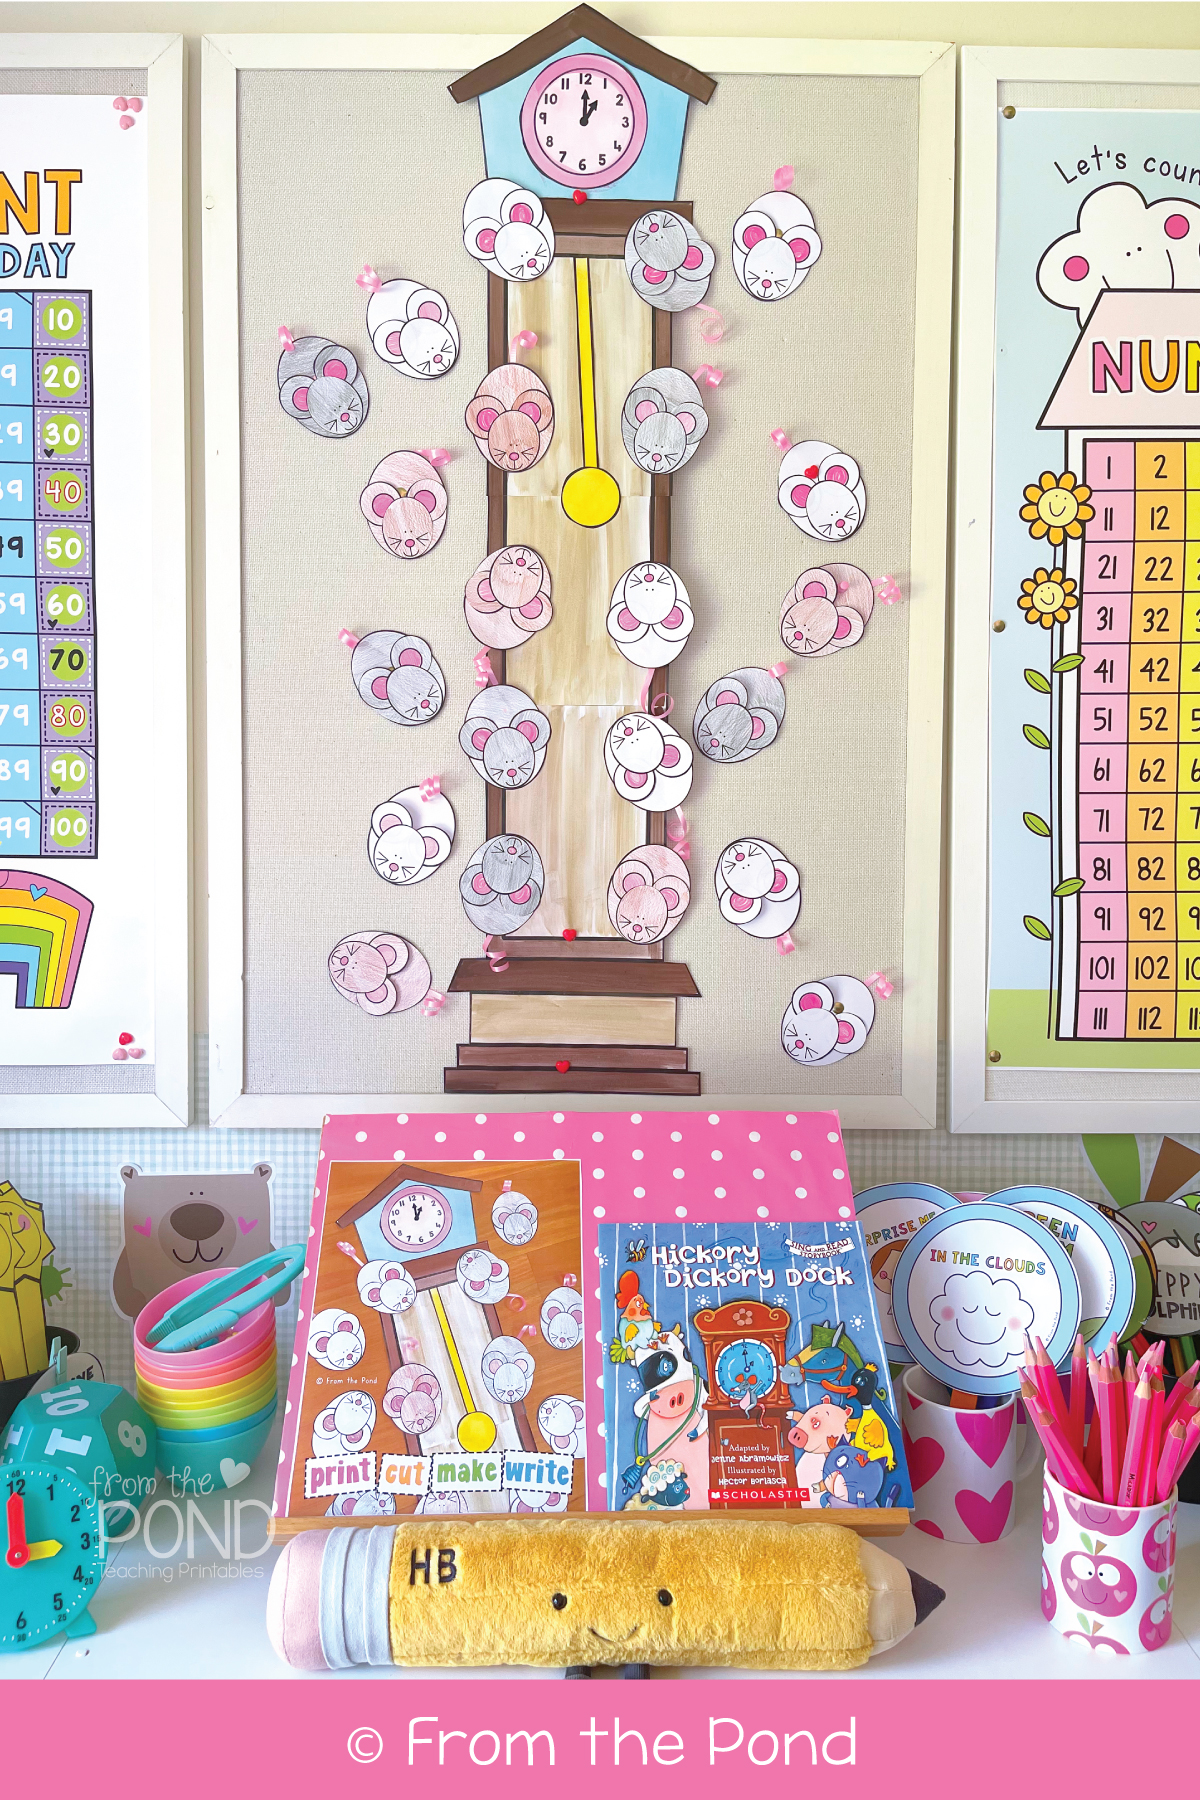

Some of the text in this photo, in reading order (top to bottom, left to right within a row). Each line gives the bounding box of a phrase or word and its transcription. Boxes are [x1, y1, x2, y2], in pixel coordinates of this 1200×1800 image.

[561, 78, 570, 90] 11
[579, 73, 592, 85] 12
[603, 78, 608, 90] 1
[544, 94, 558, 104] 10
[616, 94, 624, 106] 2
[539, 112, 547, 124] 9
[622, 116, 630, 128] 3
[546, 136, 554, 148] 8
[614, 140, 622, 152] 4
[558, 151, 567, 162] 7
[578, 159, 586, 170] 6
[598, 154, 606, 166] 5
[1054, 144, 1127, 184] Let's
[48, 308, 74, 331] 10
[44, 364, 81, 388] 20
[0, 422, 80, 446] 9 30
[1107, 454, 1168, 480] 1 2
[45, 480, 82, 503] 40
[1104, 506, 1170, 531] 11 12
[46, 536, 82, 559] 50
[1098, 554, 1117, 580] 21
[1144, 556, 1173, 582] 22
[47, 594, 83, 616] 60
[1096, 606, 1114, 631] 31
[1143, 607, 1170, 632] 32
[50, 649, 84, 671] 70
[1094, 658, 1114, 684] 41
[1140, 657, 1170, 682] 42
[50, 704, 86, 727] 80
[1094, 707, 1112, 732] 51
[1140, 706, 1168, 732] 52
[51, 760, 86, 782] 90
[1094, 757, 1110, 782] 61
[1139, 758, 1166, 783] 62
[50, 818, 87, 838] 100
[1093, 808, 1110, 832] 71
[1138, 806, 1165, 831] 72
[1093, 856, 1111, 882] 81
[1138, 856, 1166, 882] 82
[1094, 906, 1111, 931] 91
[1138, 906, 1166, 932] 92
[1090, 956, 1115, 980] 101
[1135, 956, 1170, 980] 102
[1094, 1007, 1108, 1030] 111
[1138, 1006, 1162, 1030] 112
[790, 1240, 811, 1252] SING
[826, 1238, 849, 1251] READ
[930, 1249, 1046, 1275] IN THE CLOUDS
[118, 1420, 147, 1458] 8
[728, 1444, 770, 1453] Adapted by
[310, 1458, 570, 1494] print cut make write
[768, 1466, 776, 1475] by
[47, 1484, 54, 1500] 1
[723, 1490, 808, 1499] SCHOLASTIC
[70, 1504, 80, 1522] 2
[80, 1532, 90, 1550] 3
[73, 1565, 84, 1582] 4
[409, 1548, 458, 1585] HB
[85, 1577, 94, 1585] 20
[53, 1593, 63, 1610] 5
[16, 1611, 26, 1629] 6
